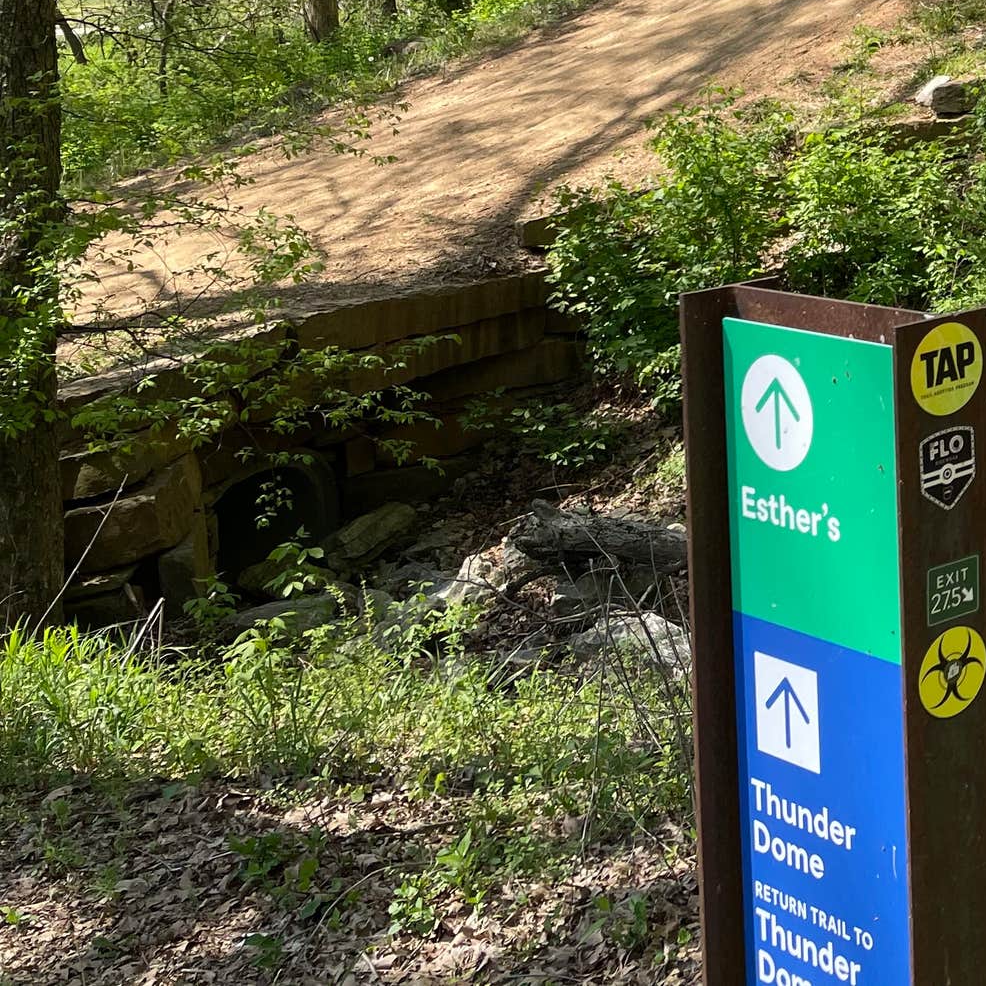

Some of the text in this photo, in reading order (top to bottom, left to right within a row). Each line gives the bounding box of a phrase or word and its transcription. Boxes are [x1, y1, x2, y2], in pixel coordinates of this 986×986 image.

[920, 341, 975, 389] TAP
[929, 434, 964, 461] FLO
[741, 485, 841, 542] Esther's
[931, 586, 962, 614] 27.5
[936, 567, 969, 589] EXIT
[750, 777, 856, 850] Thunder
[753, 819, 825, 879] Dome
[754, 880, 874, 951] RETURN TRAIL TO
[755, 907, 862, 986] Thunder
